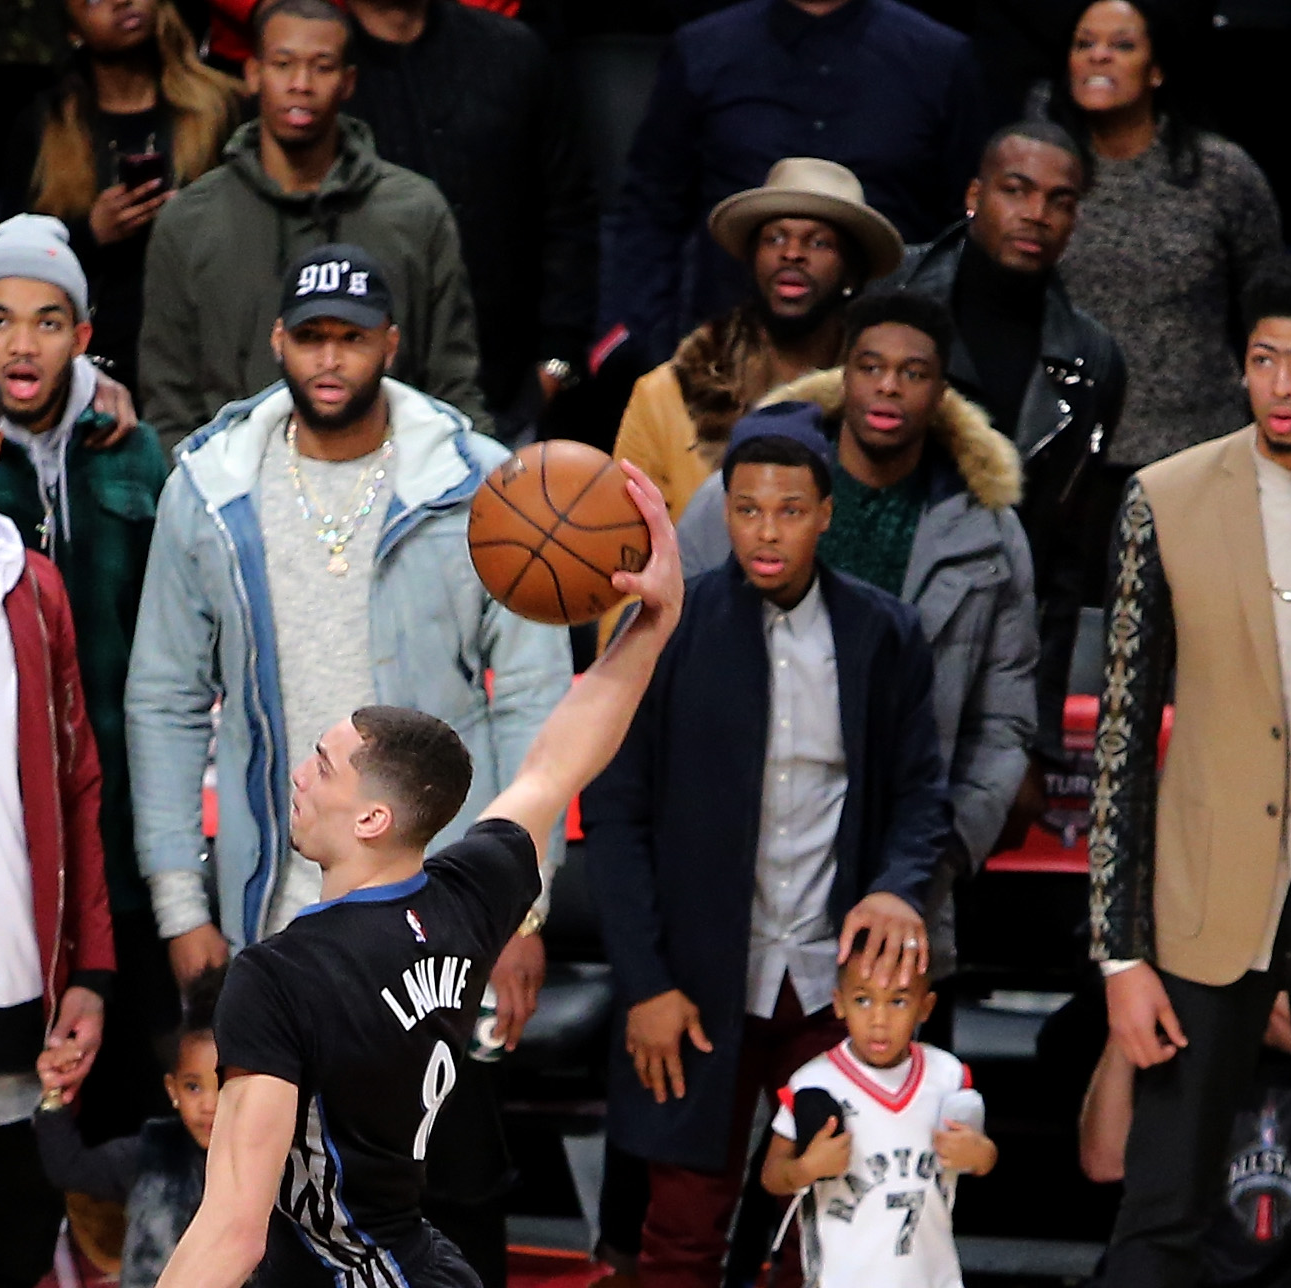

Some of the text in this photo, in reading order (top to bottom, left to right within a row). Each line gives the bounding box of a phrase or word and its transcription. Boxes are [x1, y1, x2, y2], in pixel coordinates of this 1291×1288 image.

[295, 260, 369, 297] 90's
[380, 956, 471, 1031] LAVINE
[886, 1190, 925, 1257] 7
